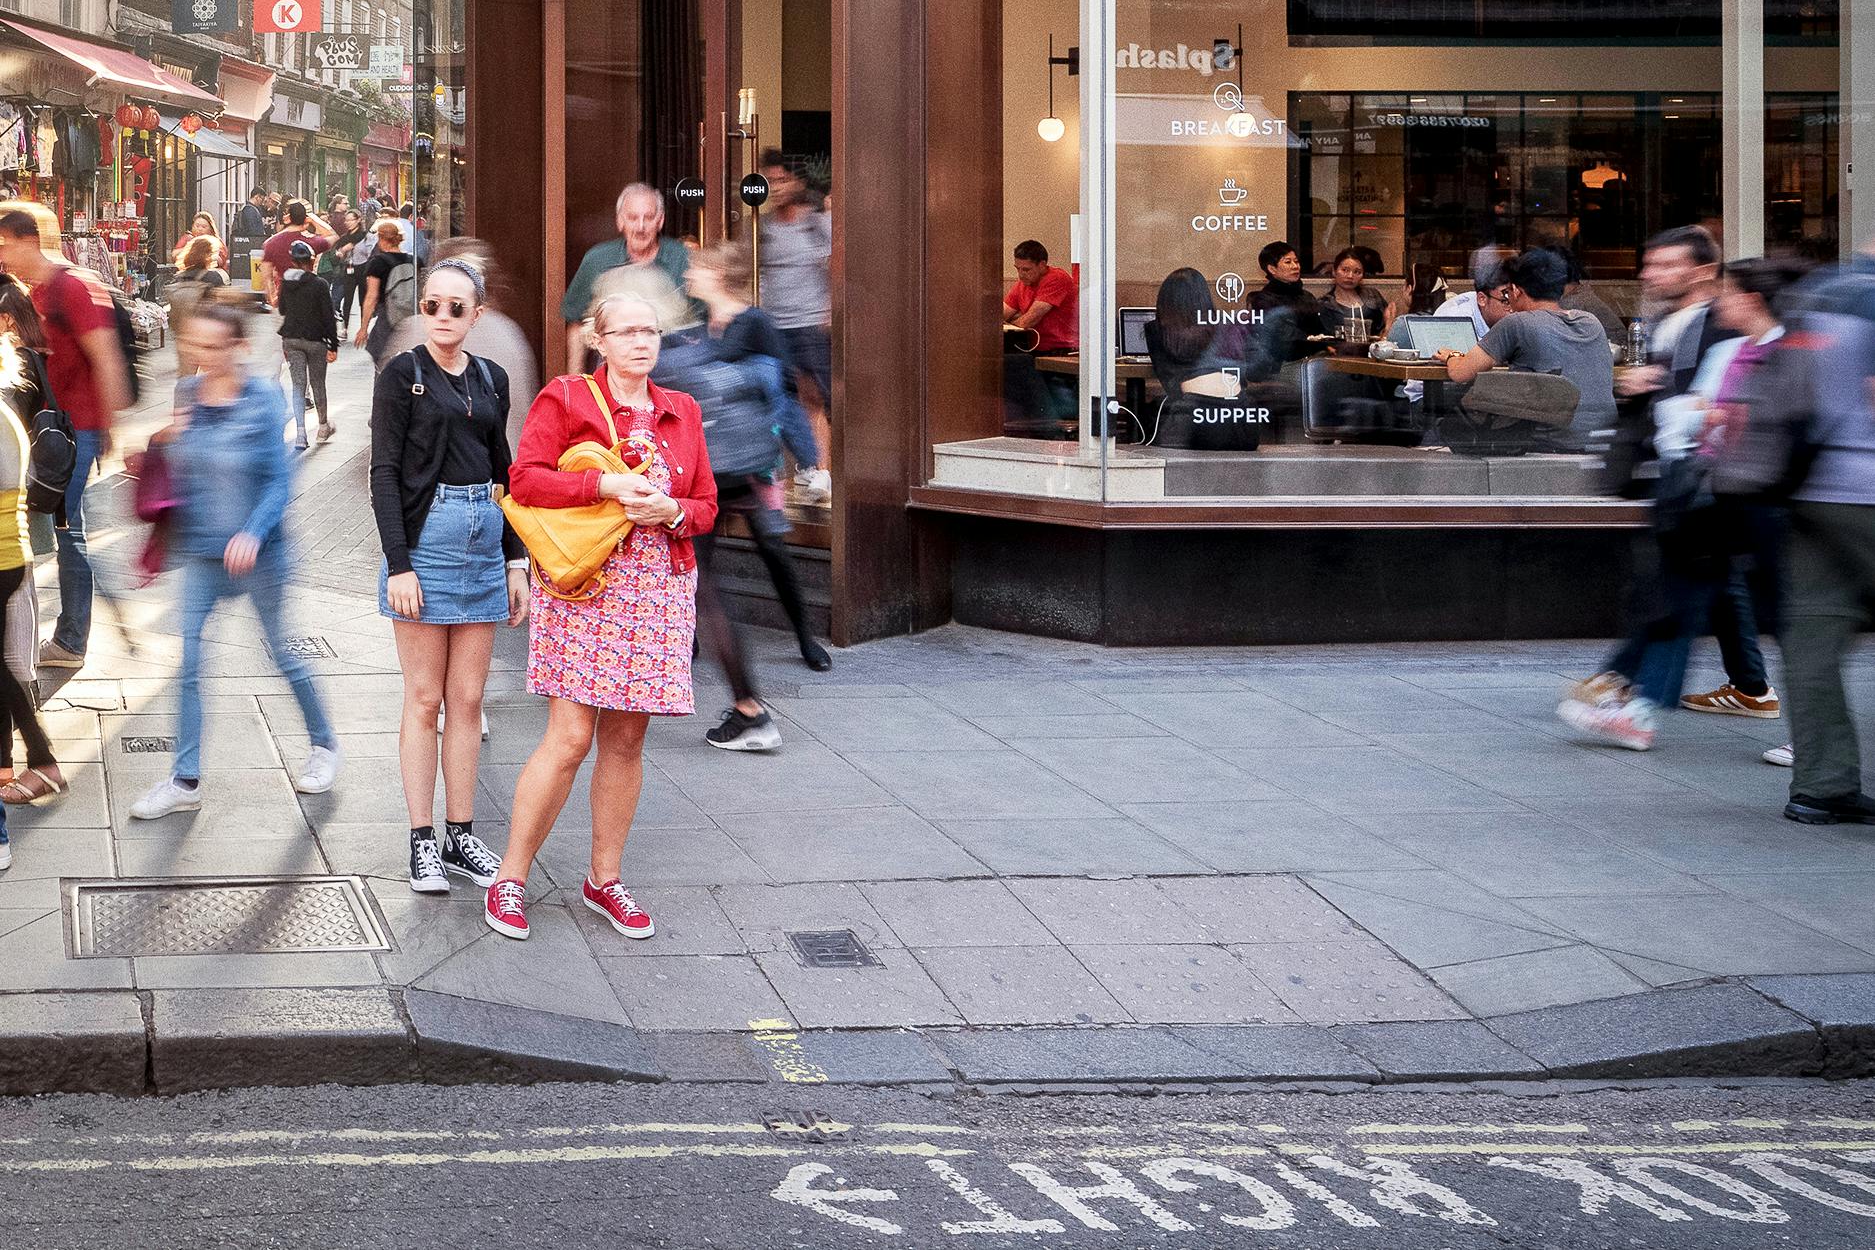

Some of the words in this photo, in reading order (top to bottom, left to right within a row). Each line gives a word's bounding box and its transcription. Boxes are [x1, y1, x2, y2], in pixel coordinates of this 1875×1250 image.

[281, 4, 296, 23] K
[1171, 120, 1287, 136] BREAKFAST
[680, 188, 705, 197] PUSH
[743, 185, 765, 194] PUSH
[1191, 215, 1268, 231] COFFEE
[1197, 309, 1264, 325] LUNCH
[1193, 408, 1270, 423] SUPPER
[924, 1154, 1498, 1235] RIGHT
[1488, 1152, 1875, 1225] OOK
